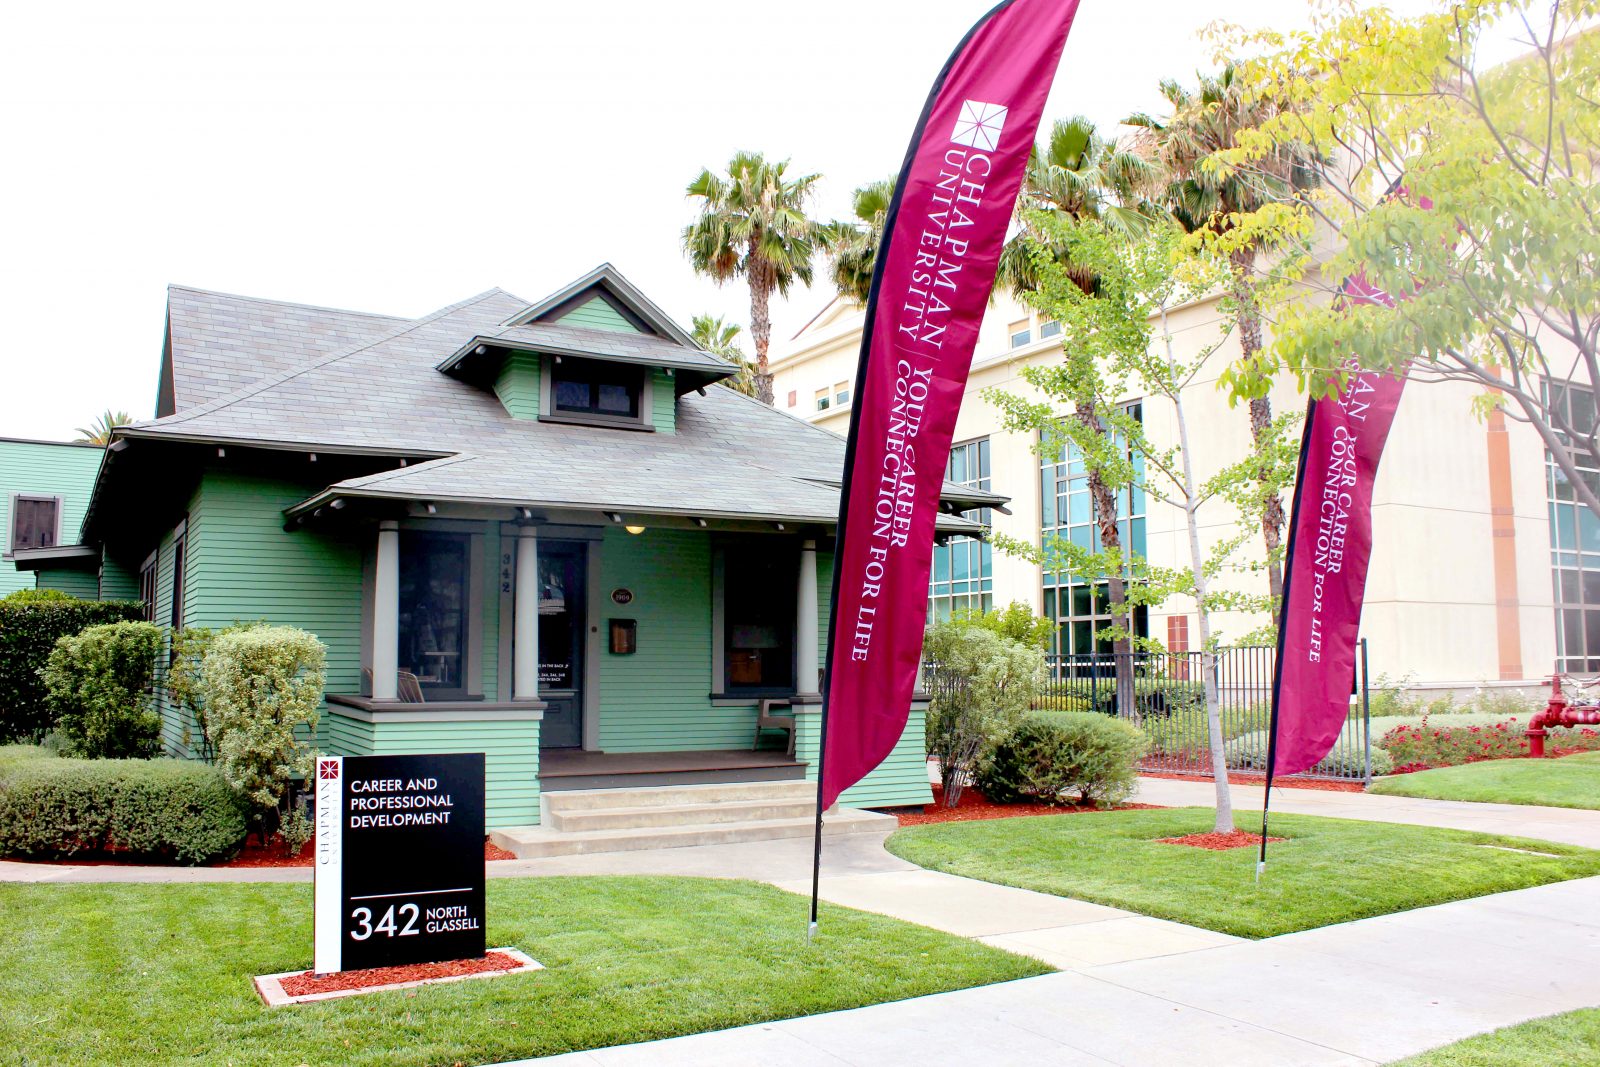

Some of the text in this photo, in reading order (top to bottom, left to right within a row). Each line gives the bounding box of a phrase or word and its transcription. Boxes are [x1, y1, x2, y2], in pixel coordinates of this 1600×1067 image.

[899, 149, 967, 341] UNIVERSITY
[920, 153, 992, 349] CHAPMAN
[890, 366, 933, 548] YOUR CAREER
[1341, 436, 1358, 488] YOUR
[851, 359, 911, 662] CONNECTION FOR LIFE
[1327, 493, 1352, 574] CAREER
[502, 553, 511, 593] 342
[1309, 425, 1347, 663] CONNECTION FOR LIFE
[350, 778, 438, 793] CAREER AND
[350, 795, 454, 810] PROFESSIONAL
[320, 782, 330, 865] CHAPMAN
[350, 812, 451, 828] DEVELOPMENT
[350, 903, 467, 941] 342 NORTH
[426, 917, 479, 933] GLASSELL
